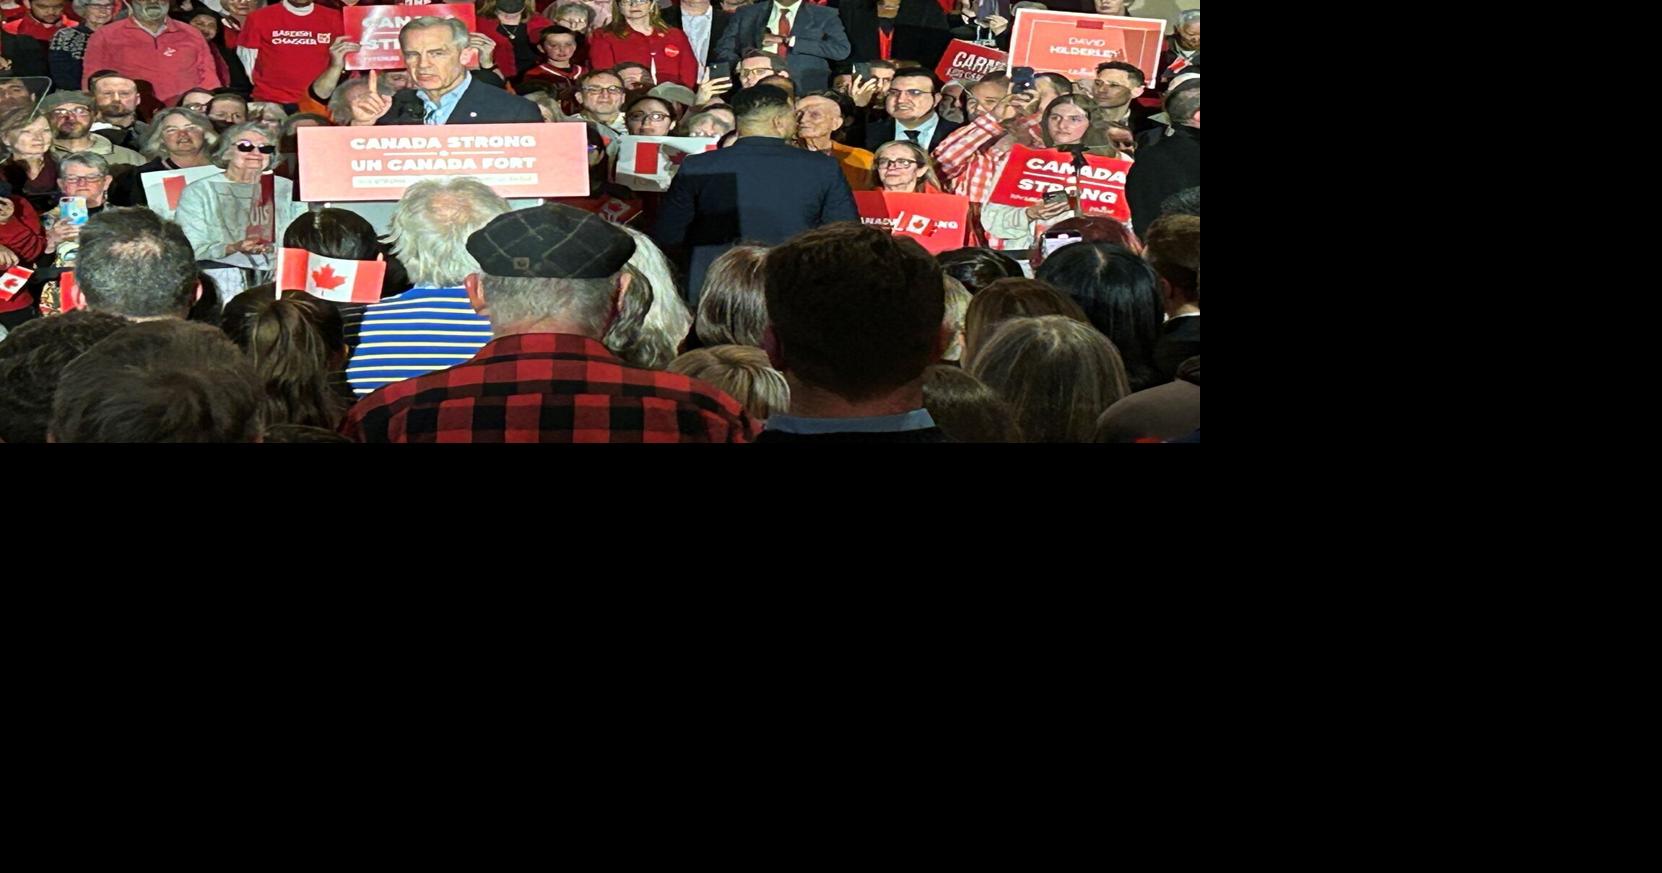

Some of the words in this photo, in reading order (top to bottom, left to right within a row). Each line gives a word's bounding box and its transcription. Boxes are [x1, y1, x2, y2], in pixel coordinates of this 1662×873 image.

[1068, 37, 1105, 47] DAVID
[350, 137, 442, 150] CANADA
[447, 135, 537, 148] STRONG
[351, 159, 382, 171] UN
[387, 158, 477, 171] CANADA
[482, 157, 537, 169] FORT
[1026, 158, 1127, 184] CANADA
